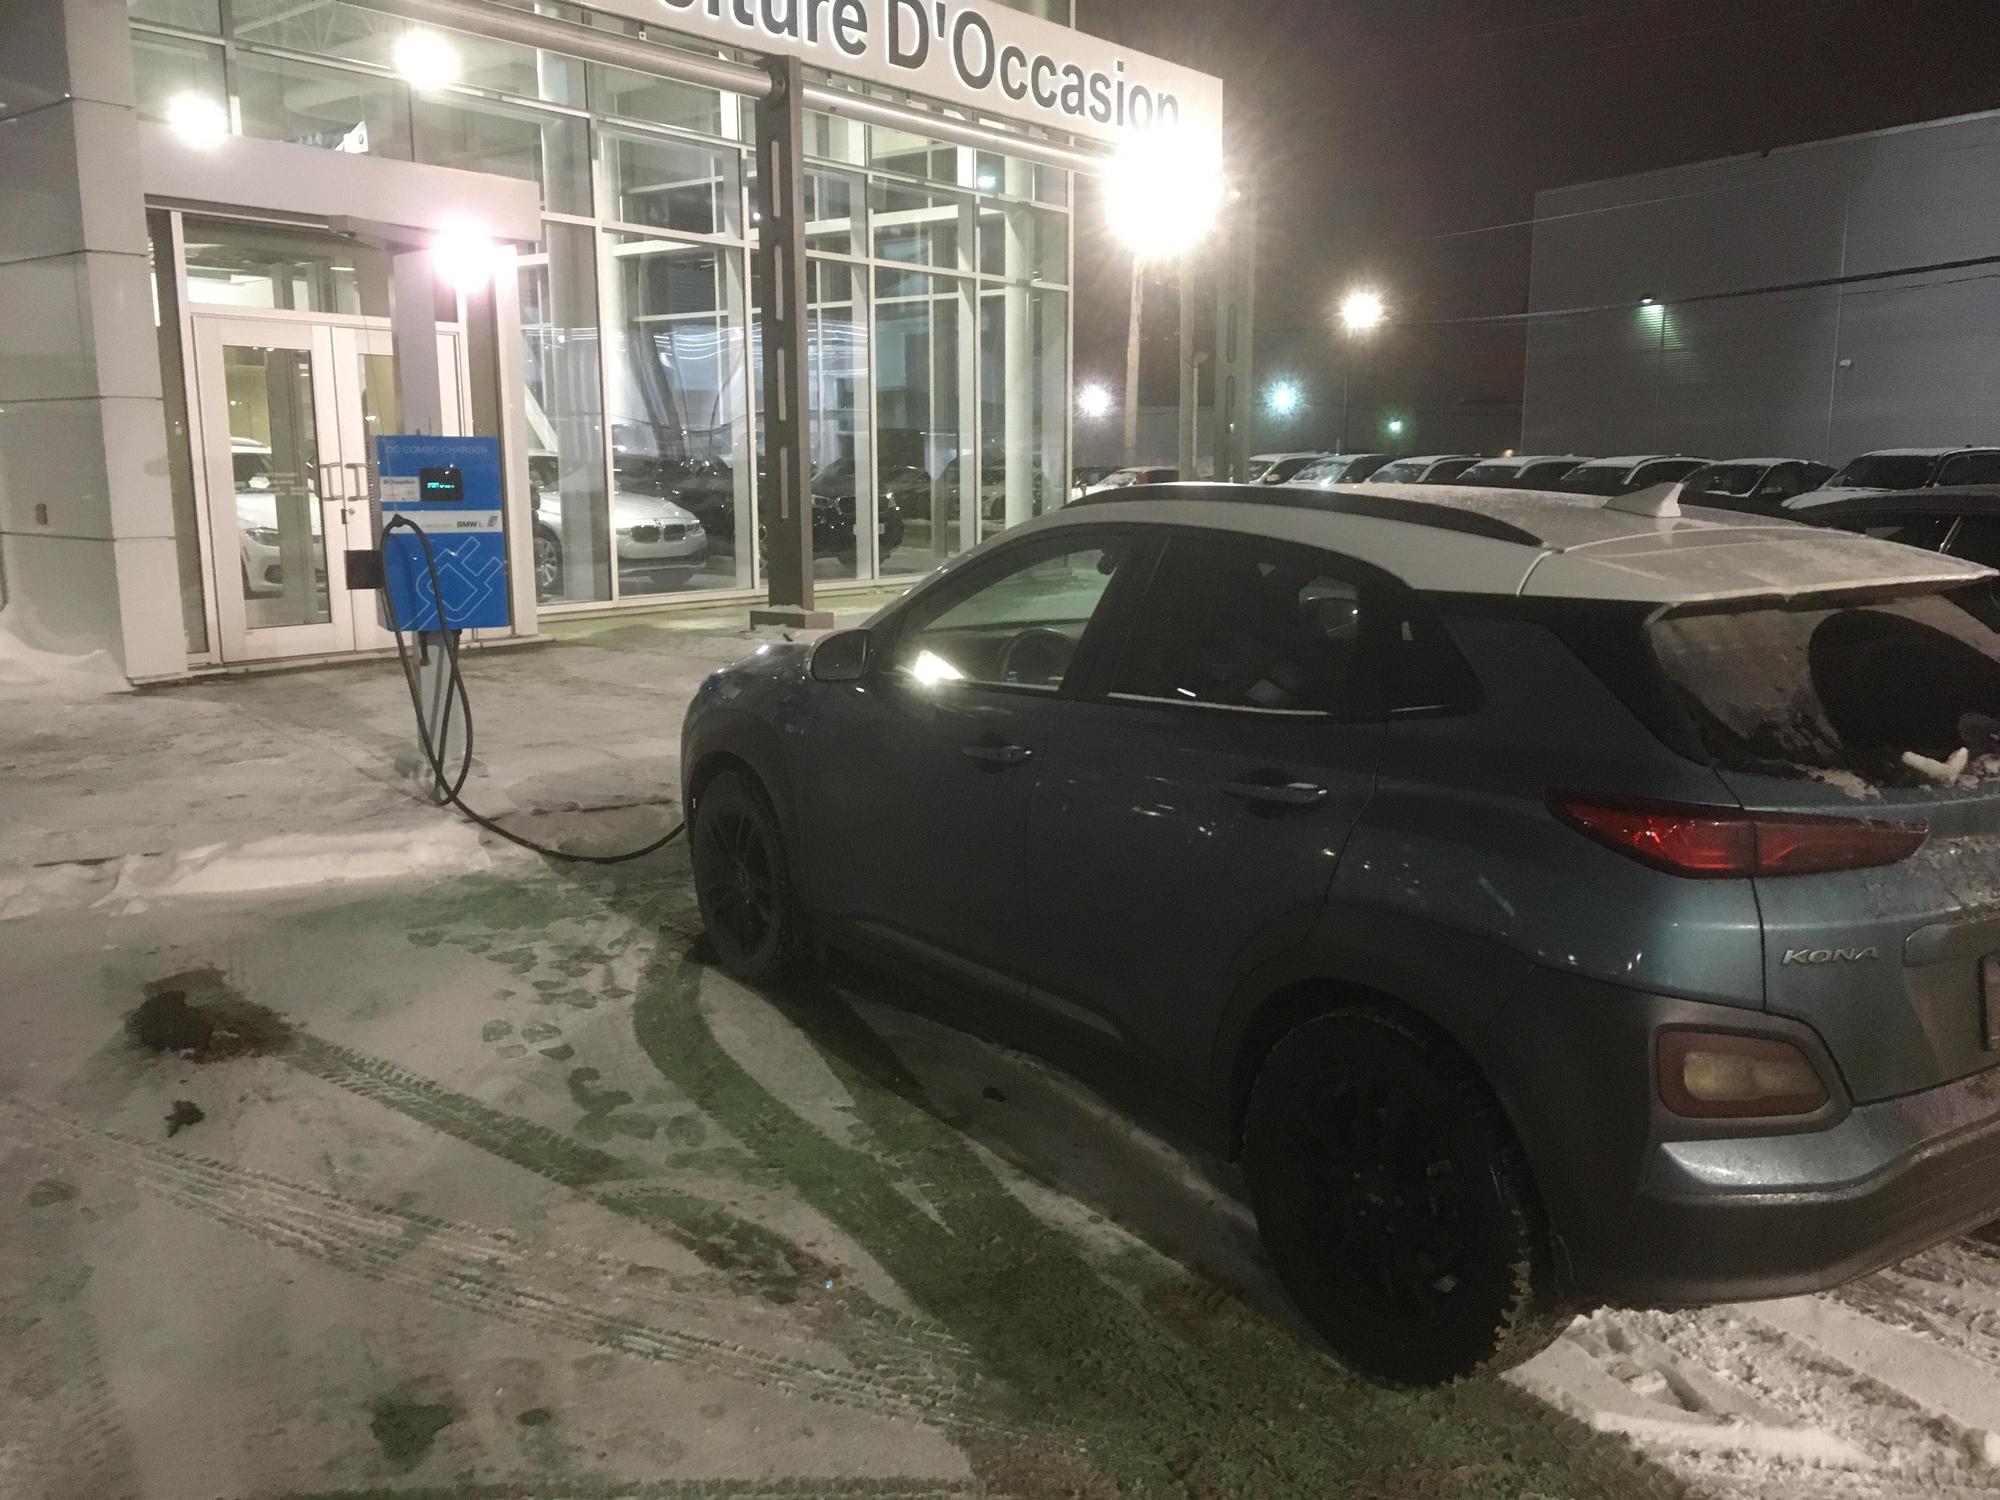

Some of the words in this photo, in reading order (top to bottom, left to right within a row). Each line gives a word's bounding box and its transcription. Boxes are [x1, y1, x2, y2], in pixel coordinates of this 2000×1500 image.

[888, 0, 1179, 133] D'Occasion
[441, 445, 489, 455] CHARGER
[456, 521, 478, 529] BMW
[1782, 946, 1880, 964] KONA
